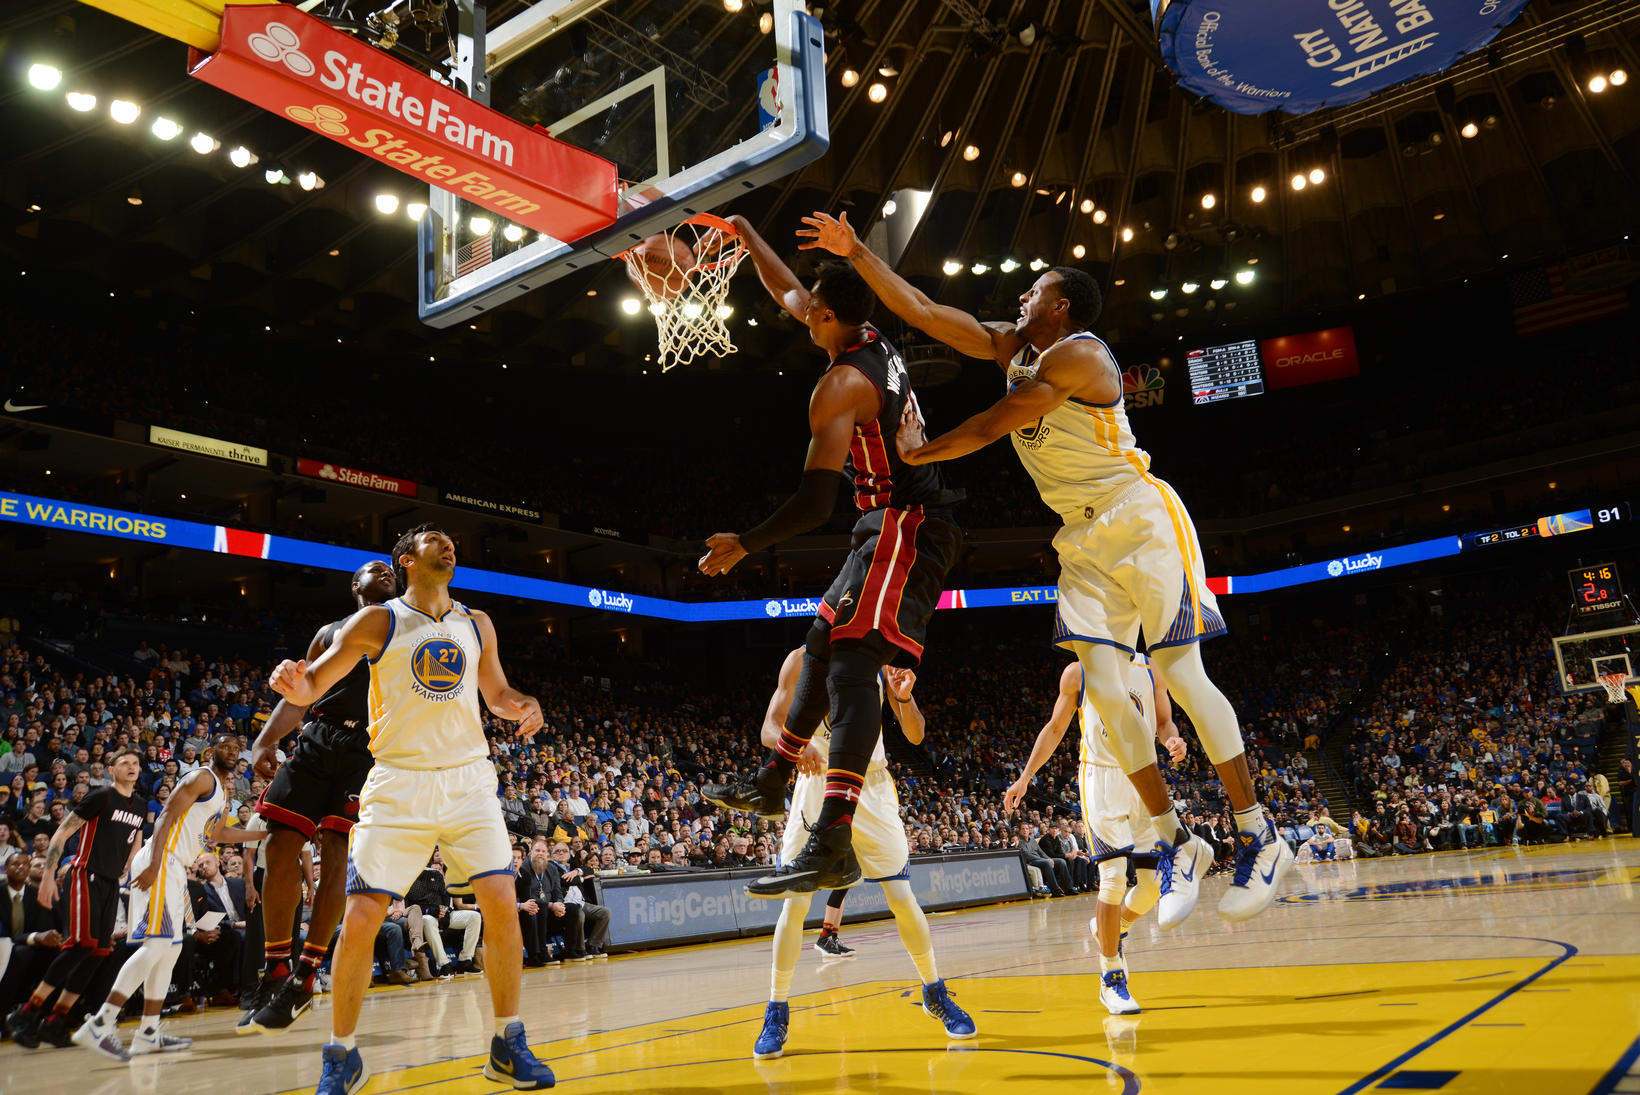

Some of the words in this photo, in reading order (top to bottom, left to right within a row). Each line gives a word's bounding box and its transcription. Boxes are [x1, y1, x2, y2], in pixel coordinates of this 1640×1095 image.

[1293, 29, 1342, 68] CITY
[1236, 82, 1291, 97] Warriors
[1276, 348, 1344, 368] ORACLE
[1123, 388, 1164, 411] CSN
[157, 437, 180, 448] KAISER
[182, 441, 225, 457] PERMANENTE
[229, 448, 260, 463] thrive
[445, 492, 497, 510] AMERICAN
[499, 504, 540, 519] EXPRESS
[25, 502, 167, 539] WARRIORS
[1480, 536, 1491, 544] TF
[1504, 531, 1521, 539] TOL
[1598, 507, 1621, 523] 91
[1343, 553, 1382, 569] Lucky
[602, 590, 633, 612] Lucky
[1011, 590, 1041, 602] EAT
[1044, 589, 1059, 600] LI
[782, 598, 821, 616] Lucky
[439, 648, 459, 663] 27
[411, 681, 465, 702] WARRIORS
[111, 809, 144, 829] MIAMI
[929, 864, 1011, 894] RingCentral
